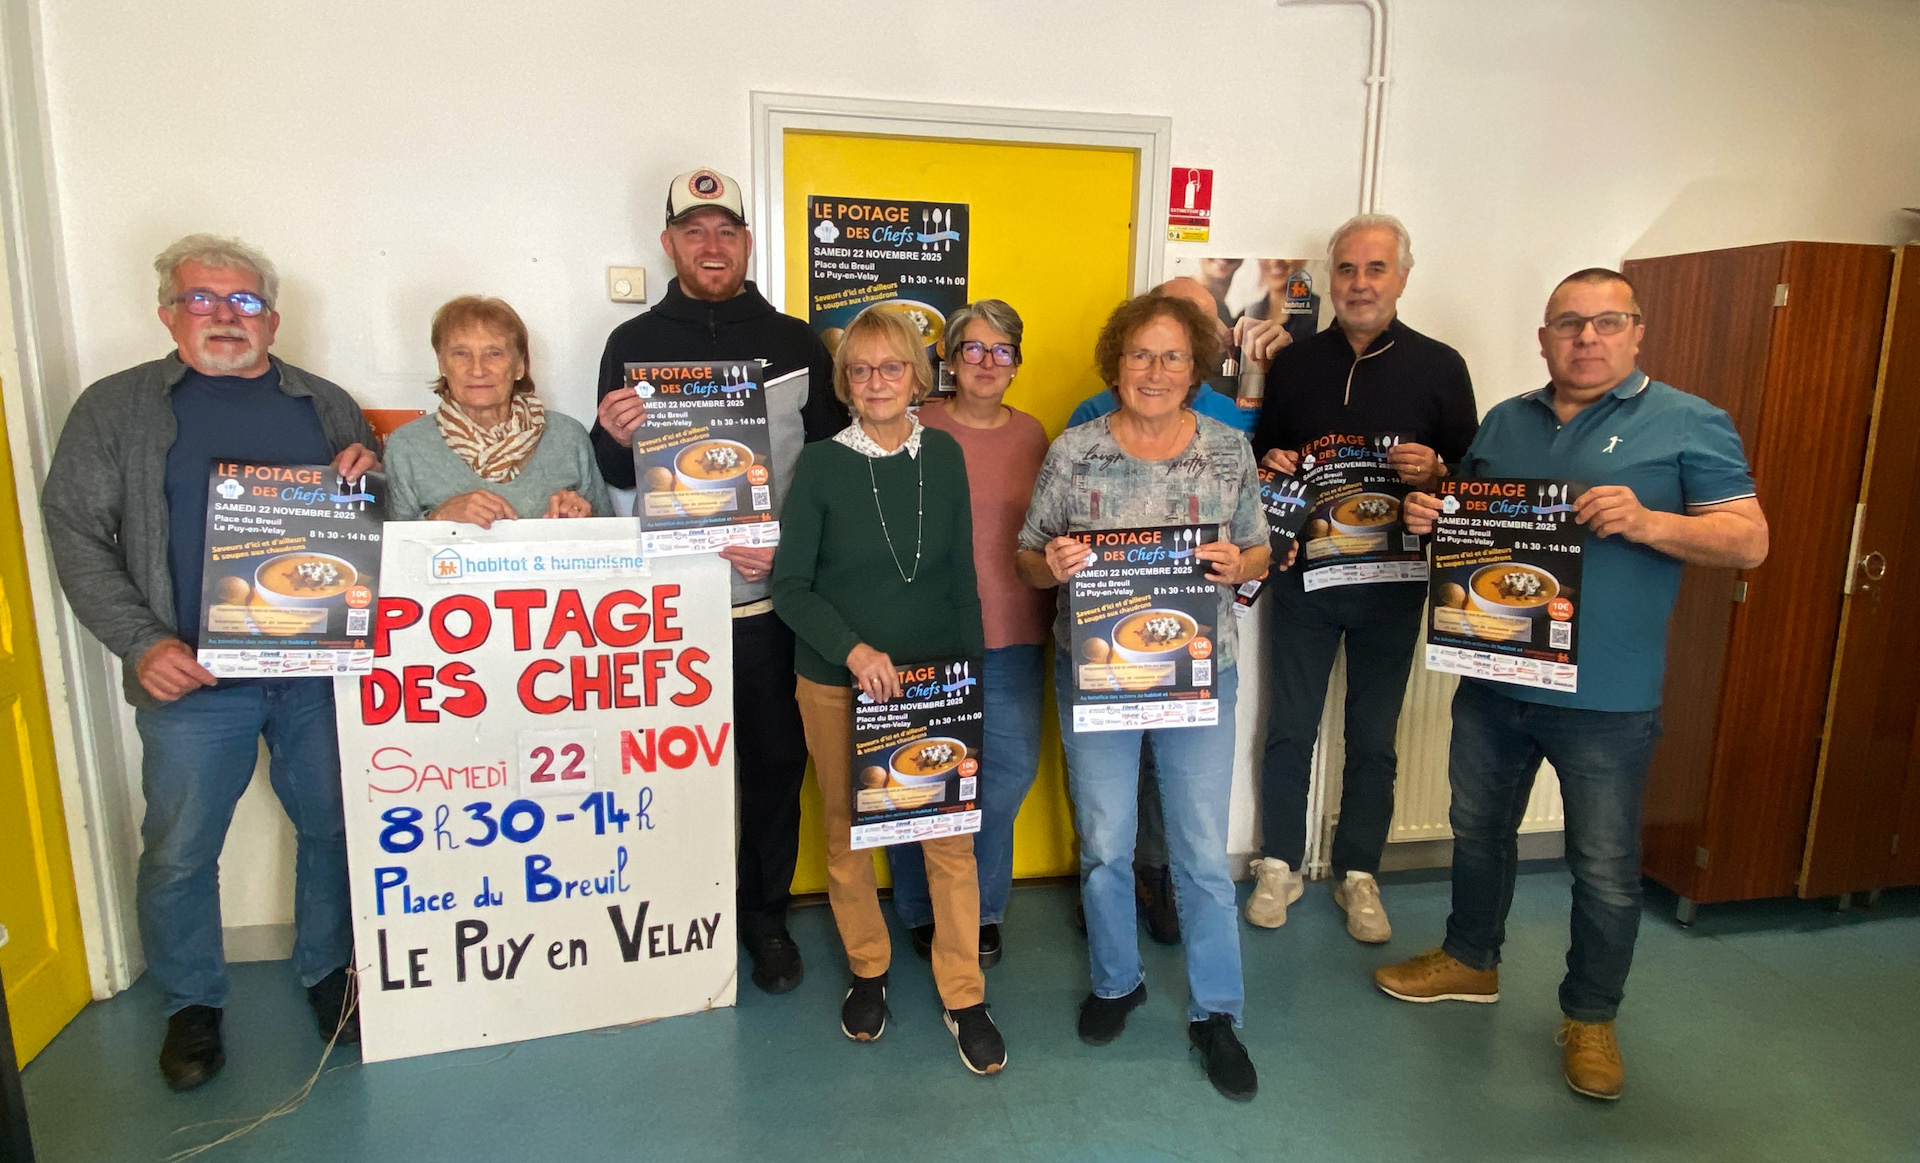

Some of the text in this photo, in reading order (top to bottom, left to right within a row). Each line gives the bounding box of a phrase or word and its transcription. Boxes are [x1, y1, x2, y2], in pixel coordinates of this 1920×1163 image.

[814, 203, 910, 222] LE POTAGE
[846, 225, 913, 247] DES Chefs
[813, 247, 942, 261] SAMEDI 22 NOVEMBRE 2025
[814, 260, 875, 271] Place du Breuil
[814, 271, 879, 282] Le Puy-en-Velay
[900, 275, 966, 286] 8 h 30 14 h 00
[814, 292, 842, 303] Saveurs
[842, 289, 857, 298] d'ici
[866, 282, 898, 293] d'ailleurs
[816, 303, 822, 311] &
[823, 300, 848, 310] soupes
[862, 290, 898, 302] chaudrons
[632, 367, 713, 380] LE POTAGE
[660, 381, 719, 398] DES Chefs
[679, 400, 725, 408] NOVEMBRE
[667, 411, 689, 419] Breuil
[647, 419, 692, 428] Puy-en-Velay
[1302, 434, 1365, 457] LE POTAGE
[1319, 446, 1370, 460] DES Chefs
[1324, 461, 1377, 471] 22 NOVEMBRE
[218, 463, 322, 485] LE POTAGE
[252, 486, 326, 506] DES Chefs
[1441, 482, 1526, 497] LE POTAGE
[214, 502, 356, 520] SAMEDI 22 NOVEMBRE 2025
[1268, 505, 1286, 517] 2025
[1466, 500, 1529, 518] DES Chefs
[215, 514, 282, 526] Place du Breuil
[1437, 516, 1557, 531] SAMEDI 22 NOVEMBRE 2025
[214, 523, 286, 536] Le Puy-en-Velay
[309, 530, 315, 538] 8
[318, 530, 325, 538] h
[327, 531, 338, 539] 30
[347, 532, 358, 540] 14
[1271, 525, 1295, 538] 14 00
[1437, 527, 1491, 537] Place du Breuil
[1096, 531, 1161, 546] POTAGE
[1447, 536, 1494, 547] Puy-en-Velay
[1514, 541, 1580, 554] 8 h 30 14 h 00
[1104, 546, 1166, 565] DES Chefs
[466, 554, 643, 573] habitat & humanisme
[1075, 566, 1193, 578] SAMEDI 22 NOVEMBRE 2025
[1076, 581, 1095, 589] Place
[1154, 587, 1159, 595] 8
[1160, 587, 1166, 595] h
[1168, 586, 1178, 594] 30
[1197, 585, 1203, 593] h
[1205, 585, 1215, 593] 00
[1086, 589, 1134, 597] Puy-en-Velay
[1553, 602, 1569, 611] 10€
[374, 584, 683, 658] POTAGE
[1193, 641, 1207, 649] 10€
[899, 667, 935, 683] TAGE
[360, 646, 713, 725] DES CHEFS
[906, 681, 940, 700] Chefs
[856, 697, 963, 714] SAMEDI 22 NOVEMBRE 2025
[856, 715, 876, 723] Place
[867, 721, 911, 730] Puy-en-Velay
[942, 717, 951, 725] 30
[530, 743, 586, 783] 22
[620, 723, 731, 774] NOV
[374, 846, 630, 916] Place du Breuil
[378, 901, 722, 991] LE PUY en VELAY
